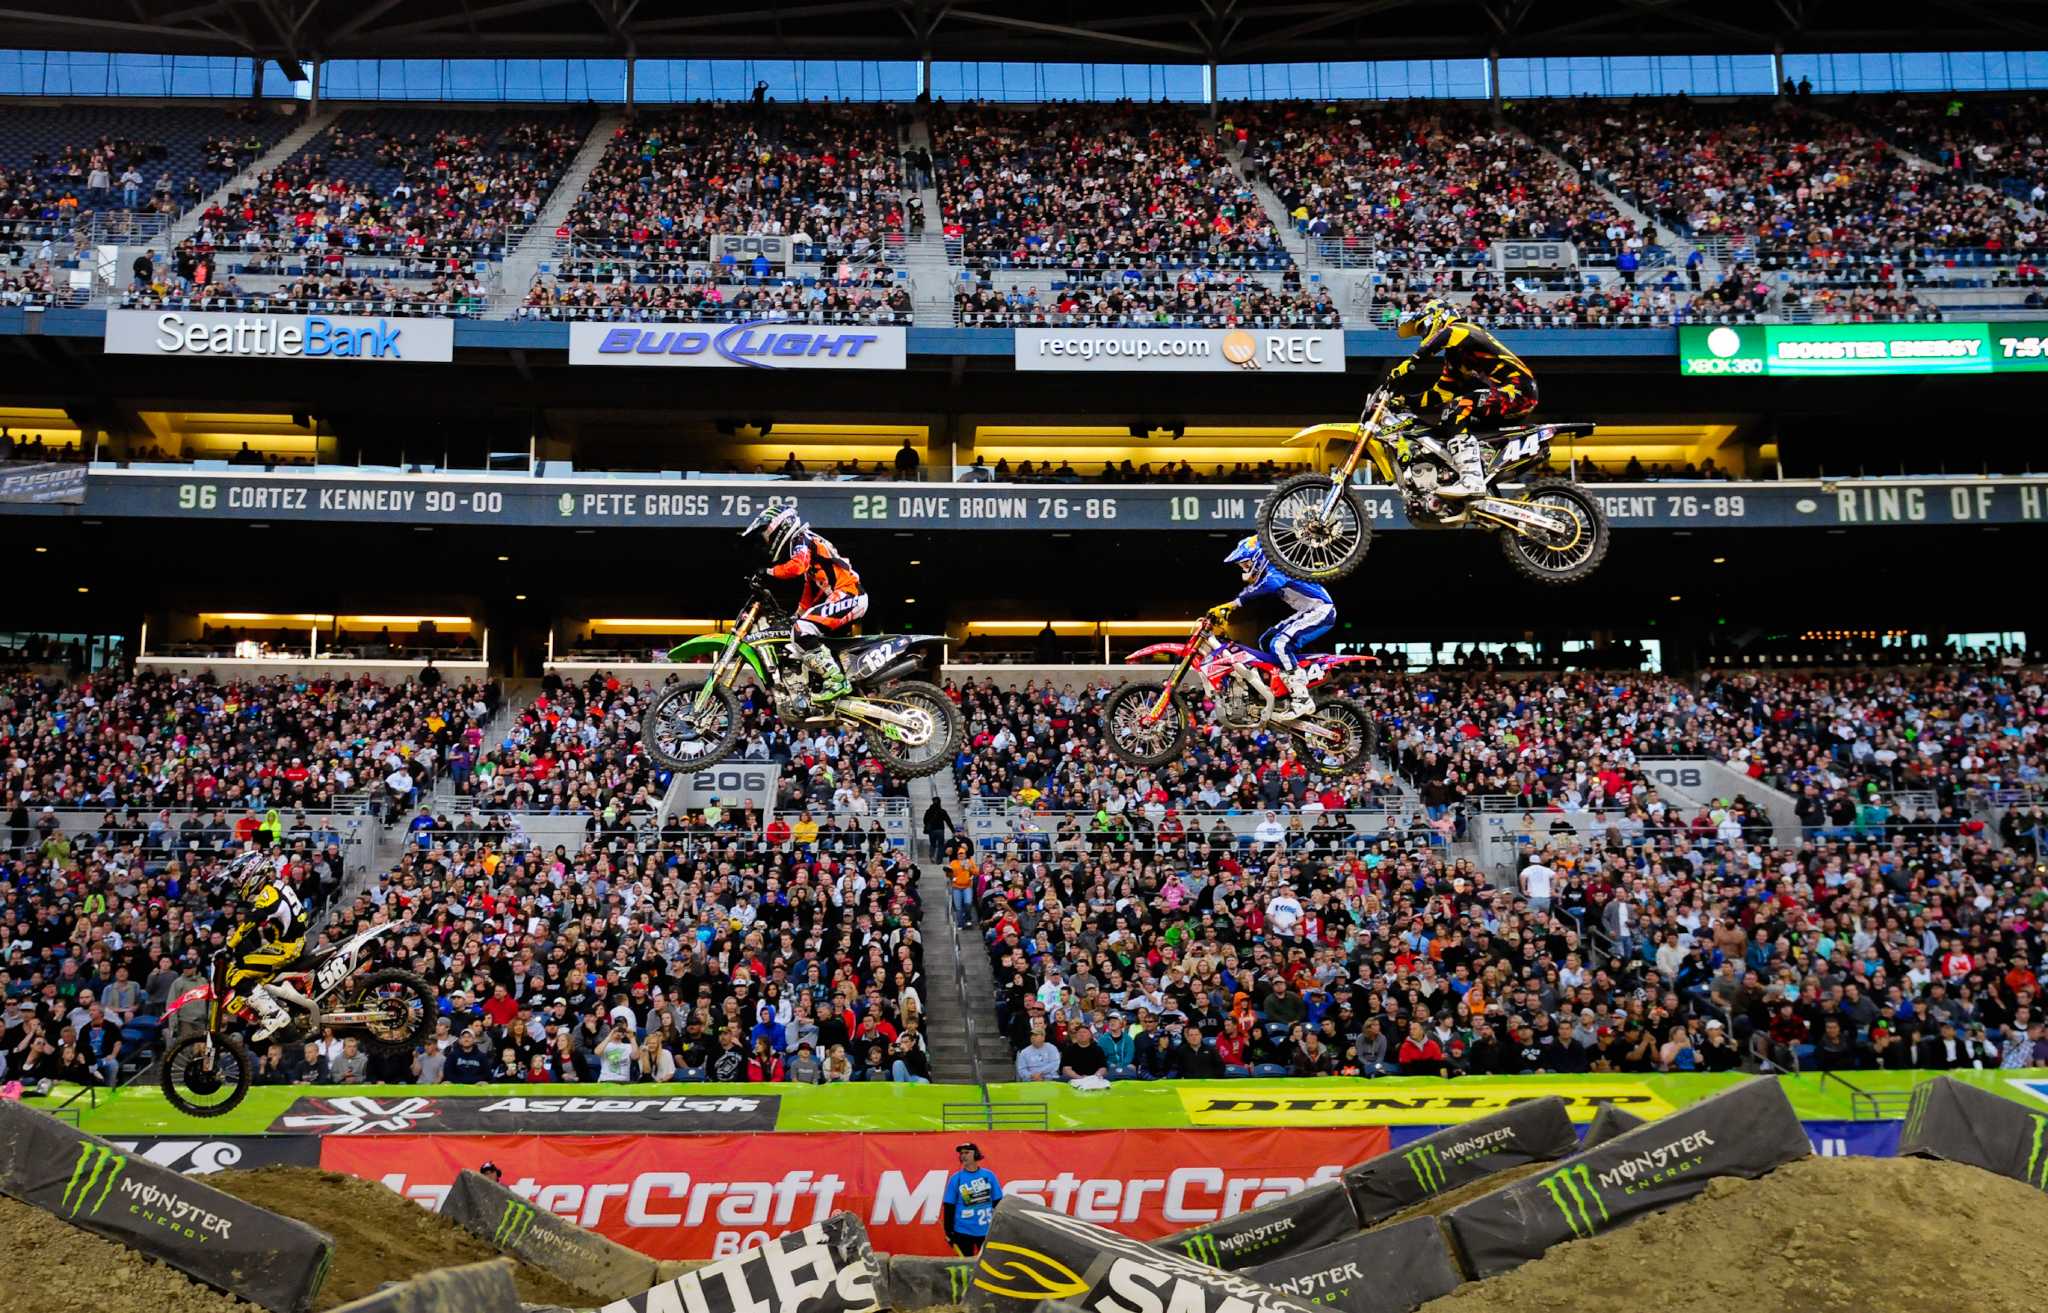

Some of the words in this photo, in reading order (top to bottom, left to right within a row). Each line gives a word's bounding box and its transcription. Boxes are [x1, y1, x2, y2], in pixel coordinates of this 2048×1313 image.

[723, 237, 781, 254] 306
[1503, 243, 1559, 260] 308
[1039, 336, 1210, 361] recgroup.com
[1265, 335, 1323, 363] REC
[1777, 341, 1887, 359] MONSTER
[1889, 339, 1983, 357] ENERGY
[1502, 432, 1539, 462] 44
[179, 486, 217, 510] 96
[228, 487, 308, 510] CORTEZ
[319, 488, 415, 513] KENNEDY
[425, 490, 503, 514] 90-00
[583, 493, 636, 515] PETE
[644, 494, 709, 517] GROSS
[853, 496, 888, 520] 22
[898, 497, 951, 519] DAVE
[959, 497, 1028, 520] BROWN
[1037, 498, 1118, 520] 76-86
[1170, 496, 1200, 521] 10
[1211, 498, 1245, 519] JIM
[1668, 496, 1745, 518] 76-89
[1837, 487, 1927, 522] RING
[1950, 486, 1995, 520] OF
[2020, 486, 2048, 520] H
[862, 643, 897, 673] 132
[692, 772, 766, 791] 206
[1642, 768, 1701, 788] 08
[478, 1096, 759, 1113] Asterisk
[1439, 1125, 1516, 1161] MONSTER
[1598, 1129, 1715, 1190] MONSTER
[1624, 1155, 1704, 1195] ENERGY
[120, 1176, 233, 1240] MONSTER
[380, 1170, 845, 1229] aterCraft
[129, 1204, 209, 1243] ENERGY
[1218, 1217, 1297, 1251] MONSTER
[1269, 1261, 1364, 1297] NSTER
